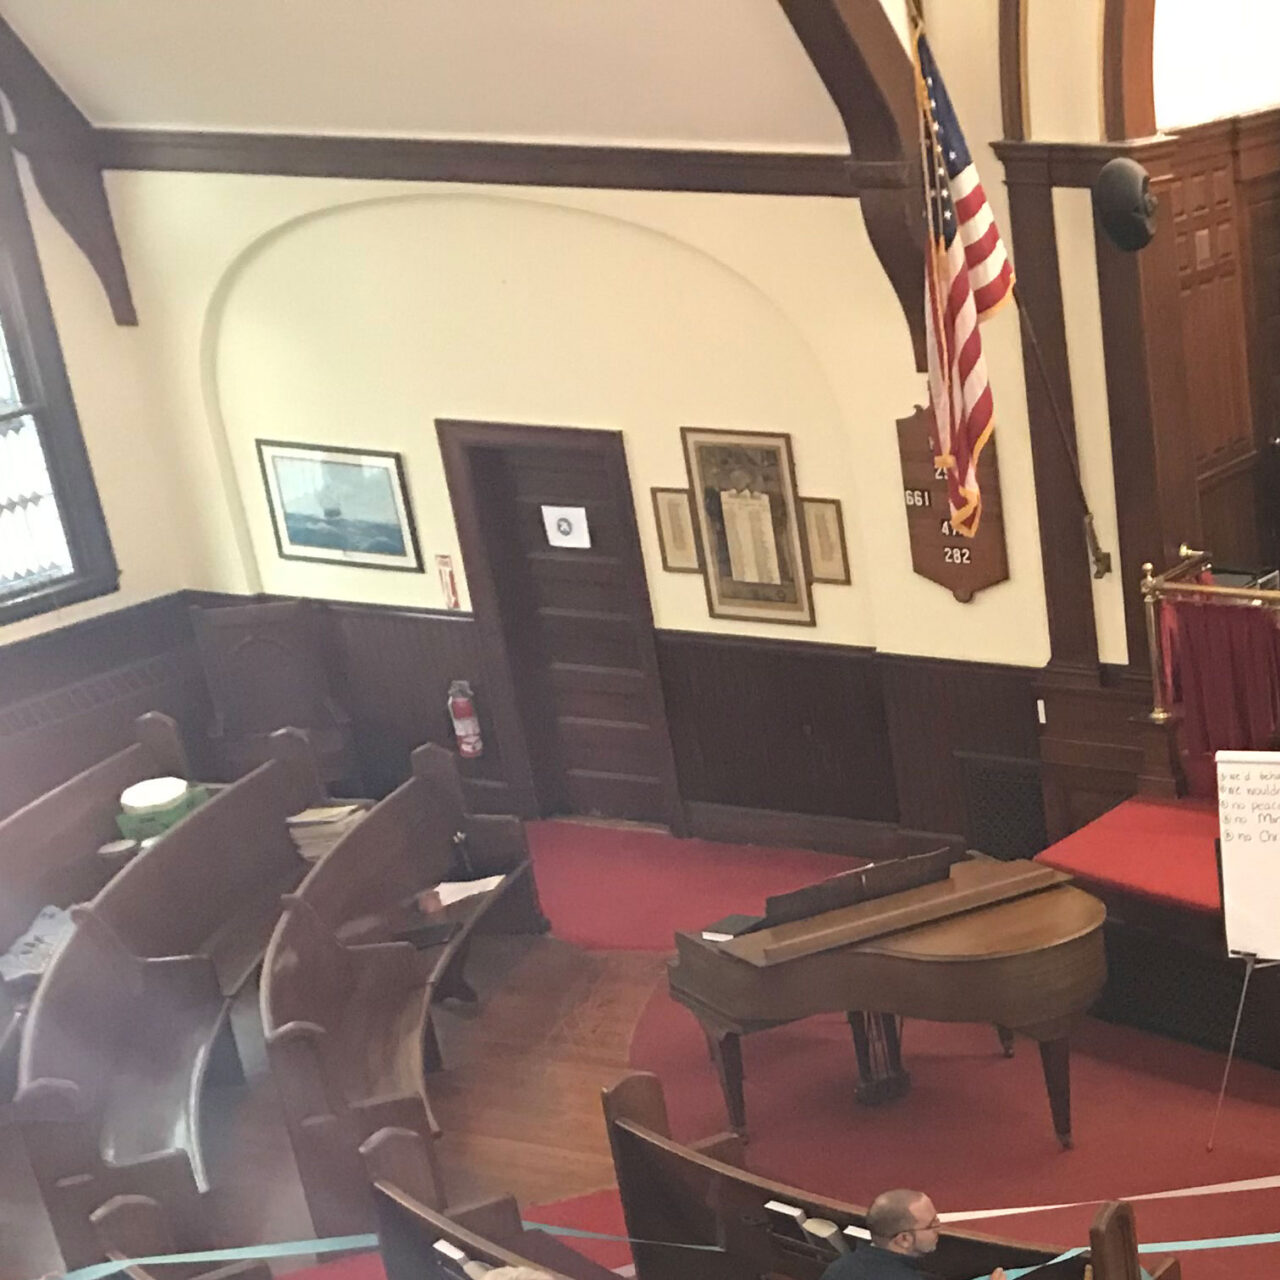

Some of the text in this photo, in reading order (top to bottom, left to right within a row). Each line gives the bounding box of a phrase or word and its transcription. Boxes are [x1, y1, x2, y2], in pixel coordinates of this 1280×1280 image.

[904, 489, 930, 507] 661
[944, 546, 971, 564] 282
[1231, 801, 1246, 810] no
[1234, 815, 1248, 825] no
[1238, 831, 1253, 842] no
